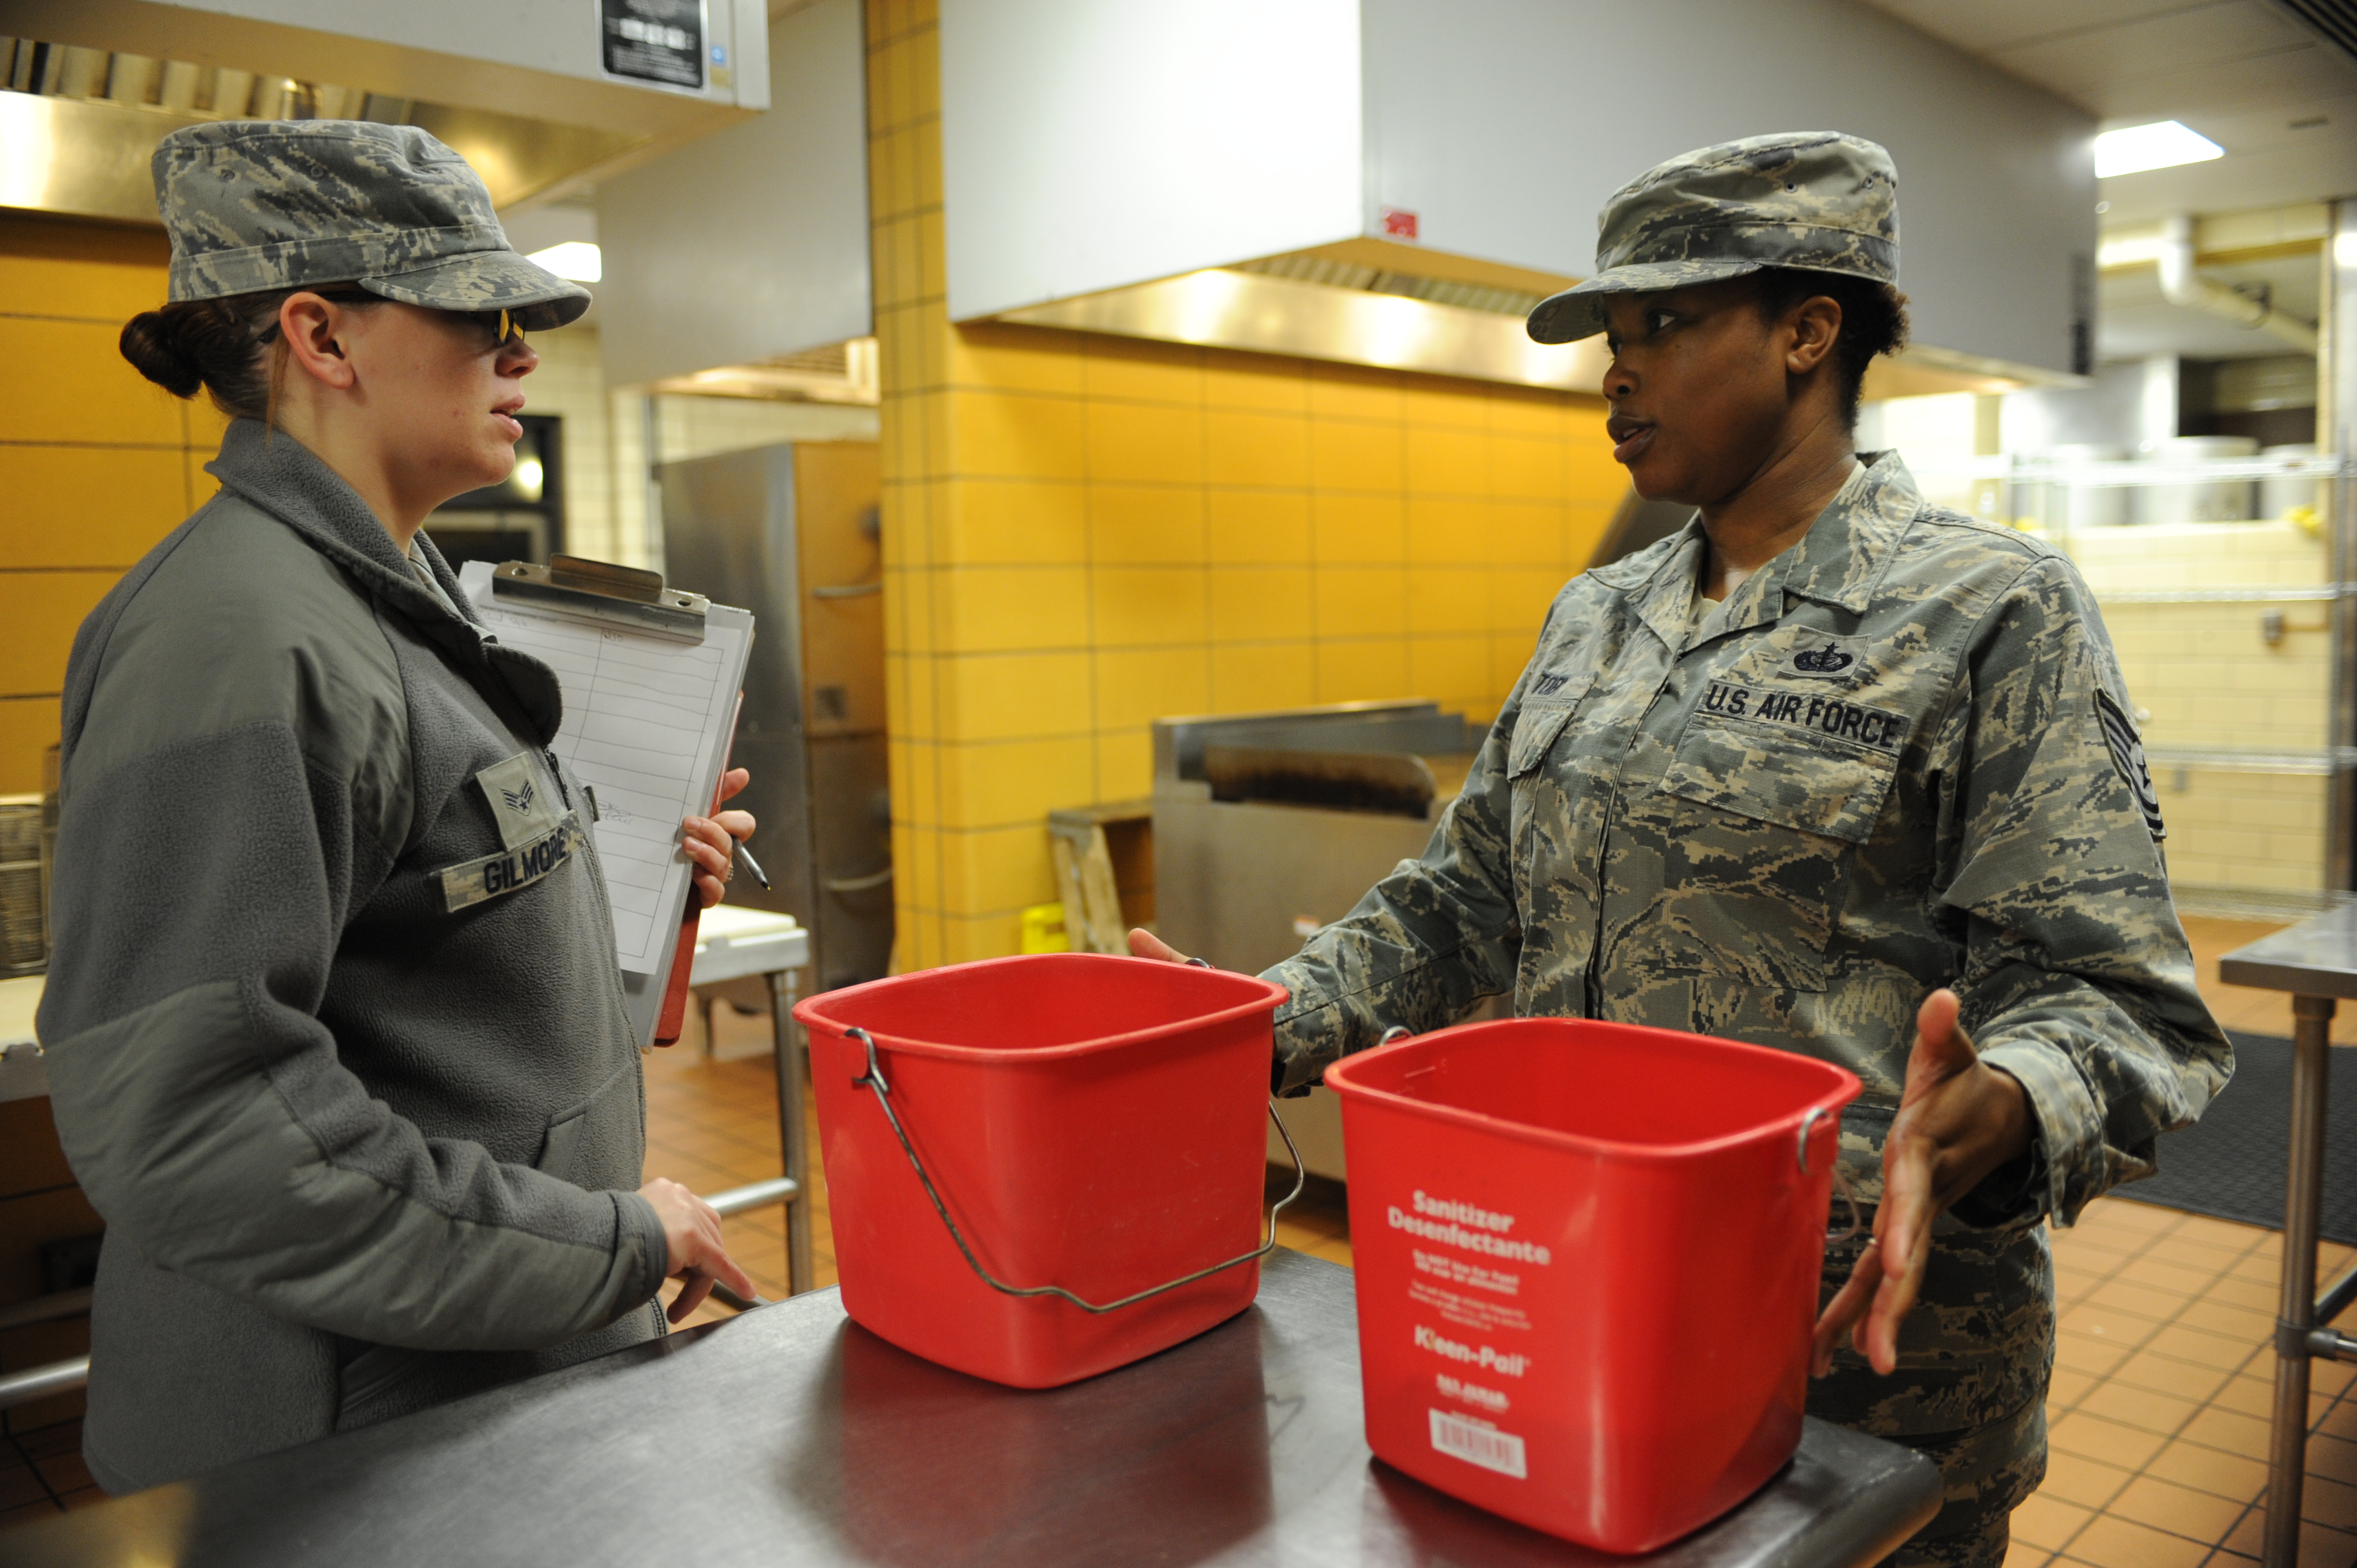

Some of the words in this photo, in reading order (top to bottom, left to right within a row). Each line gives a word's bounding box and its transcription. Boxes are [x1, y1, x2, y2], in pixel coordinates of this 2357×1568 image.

[1705, 684, 1749, 715] U.S.
[1754, 693, 1802, 723] AIR
[1805, 698, 1901, 748] FORCE
[483, 826, 567, 894] GILMORE
[1387, 1205, 1551, 1266] Desenfectante
[1412, 1189, 1515, 1233] Sanitizer
